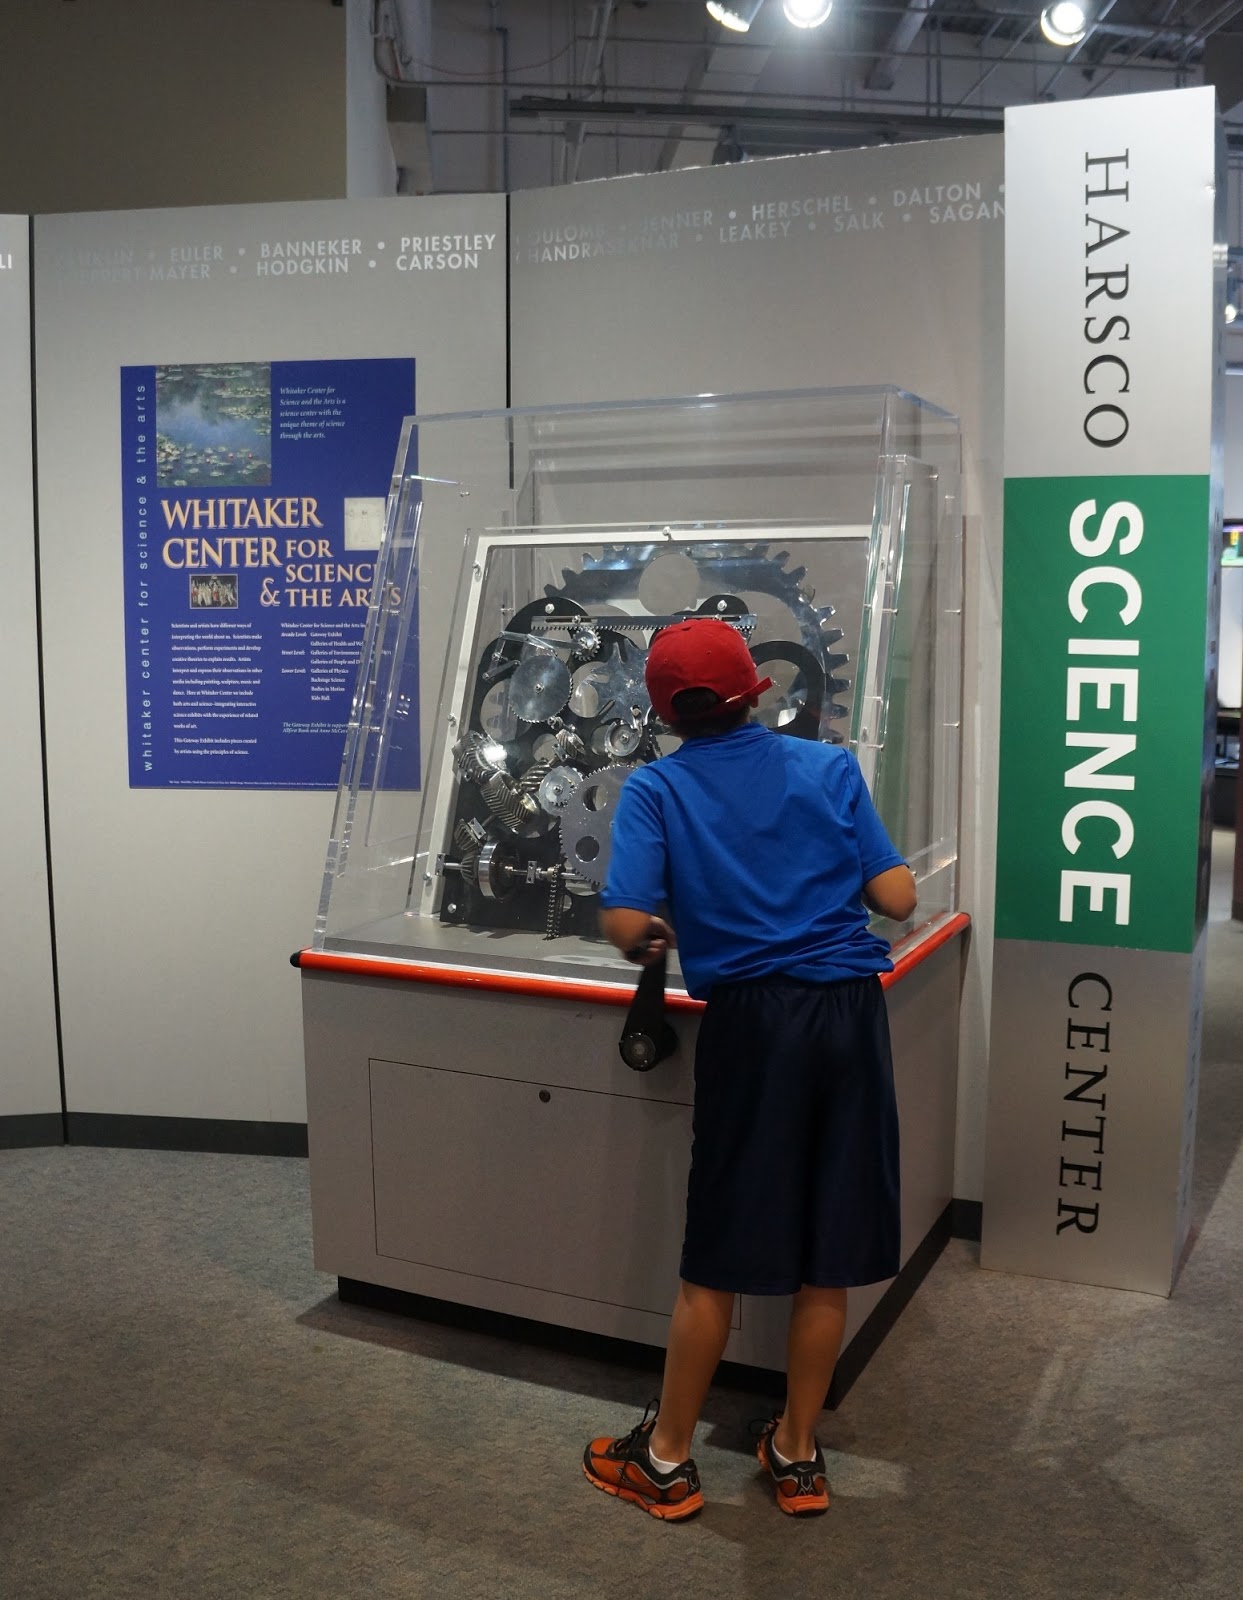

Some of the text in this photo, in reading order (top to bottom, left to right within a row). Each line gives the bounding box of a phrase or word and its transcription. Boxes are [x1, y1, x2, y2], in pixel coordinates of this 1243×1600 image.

[752, 195, 853, 221] HERSCHEL
[893, 182, 981, 207] DALTON
[719, 221, 790, 244] LEAKEY
[833, 212, 884, 232] SALK
[170, 233, 496, 264] EULER BANNEKER PRIESTLEY
[149, 262, 210, 281] MAYER
[257, 257, 349, 277] HODGKIN
[396, 253, 478, 272] CARSON
[1084, 148, 1131, 448] HARSCO
[326, 386, 335, 395] for
[280, 421, 299, 430] unique
[319, 421, 325, 429] of
[160, 498, 325, 530] WHITAKER
[162, 537, 334, 569] CENTER FOR
[136, 385, 152, 771] whitaker center for science & the arts
[285, 563, 381, 583] SCIENC
[260, 577, 280, 607] &
[285, 588, 332, 607] THE
[1059, 498, 1144, 926] SCIENCE
[1056, 971, 1113, 1236] CENTER
